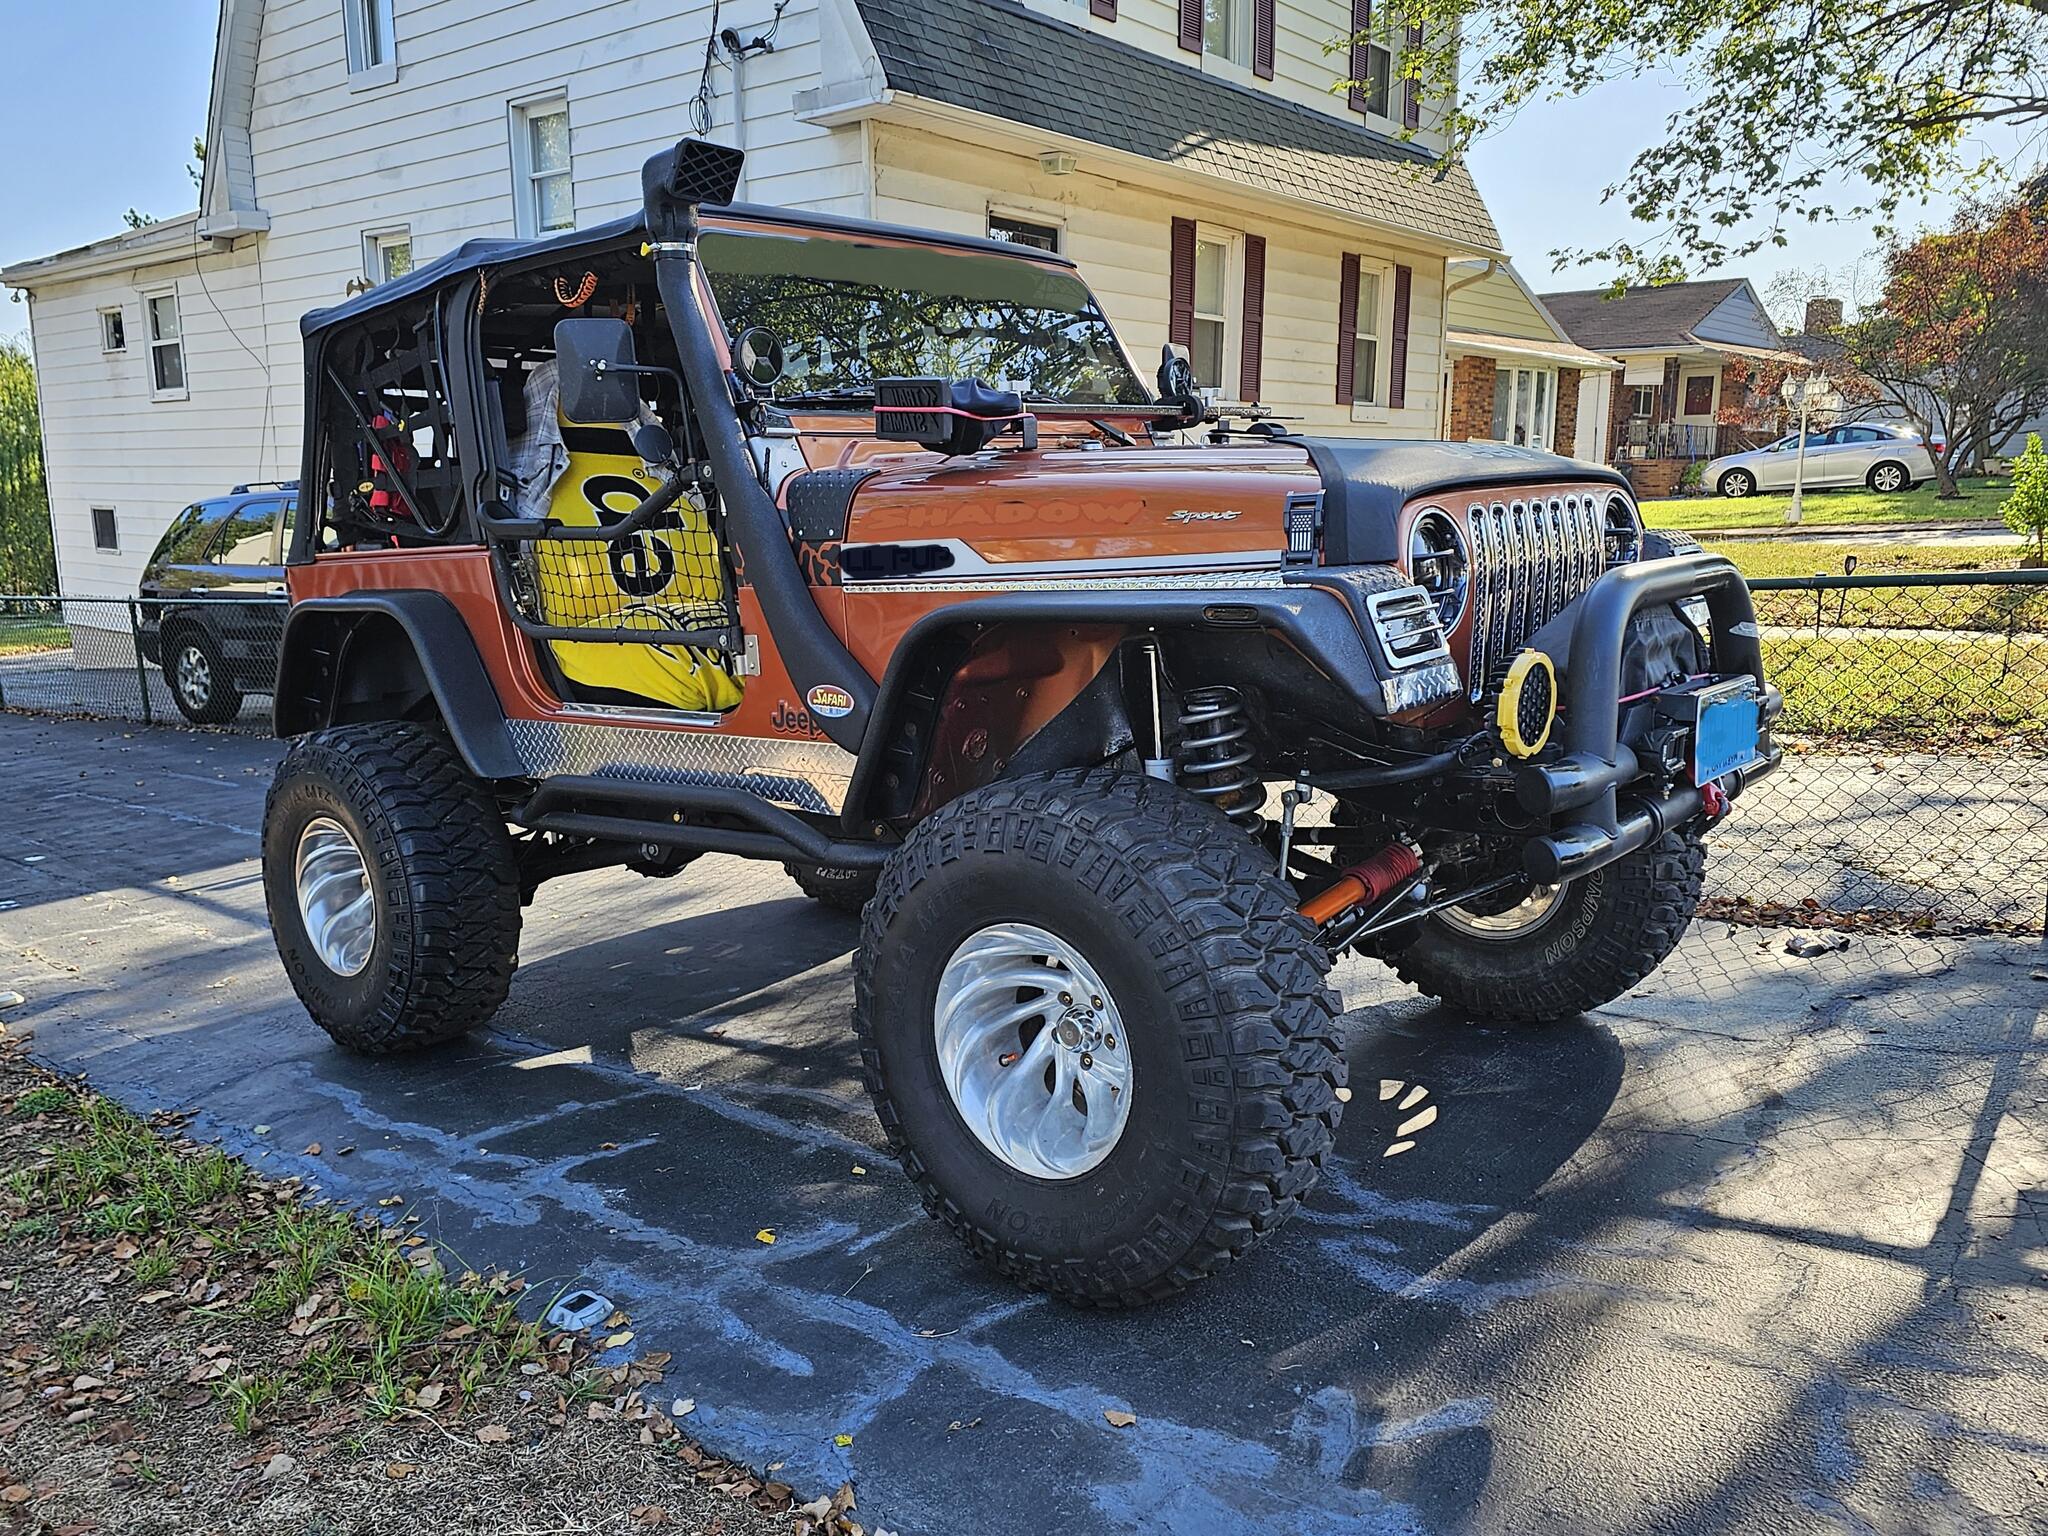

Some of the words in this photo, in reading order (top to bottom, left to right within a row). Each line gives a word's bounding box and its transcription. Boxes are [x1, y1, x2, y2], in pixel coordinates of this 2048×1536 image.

[1165, 509, 1242, 524] Sport
[813, 689, 847, 706] SAFARI
[1545, 868, 1604, 964] OMPSON
